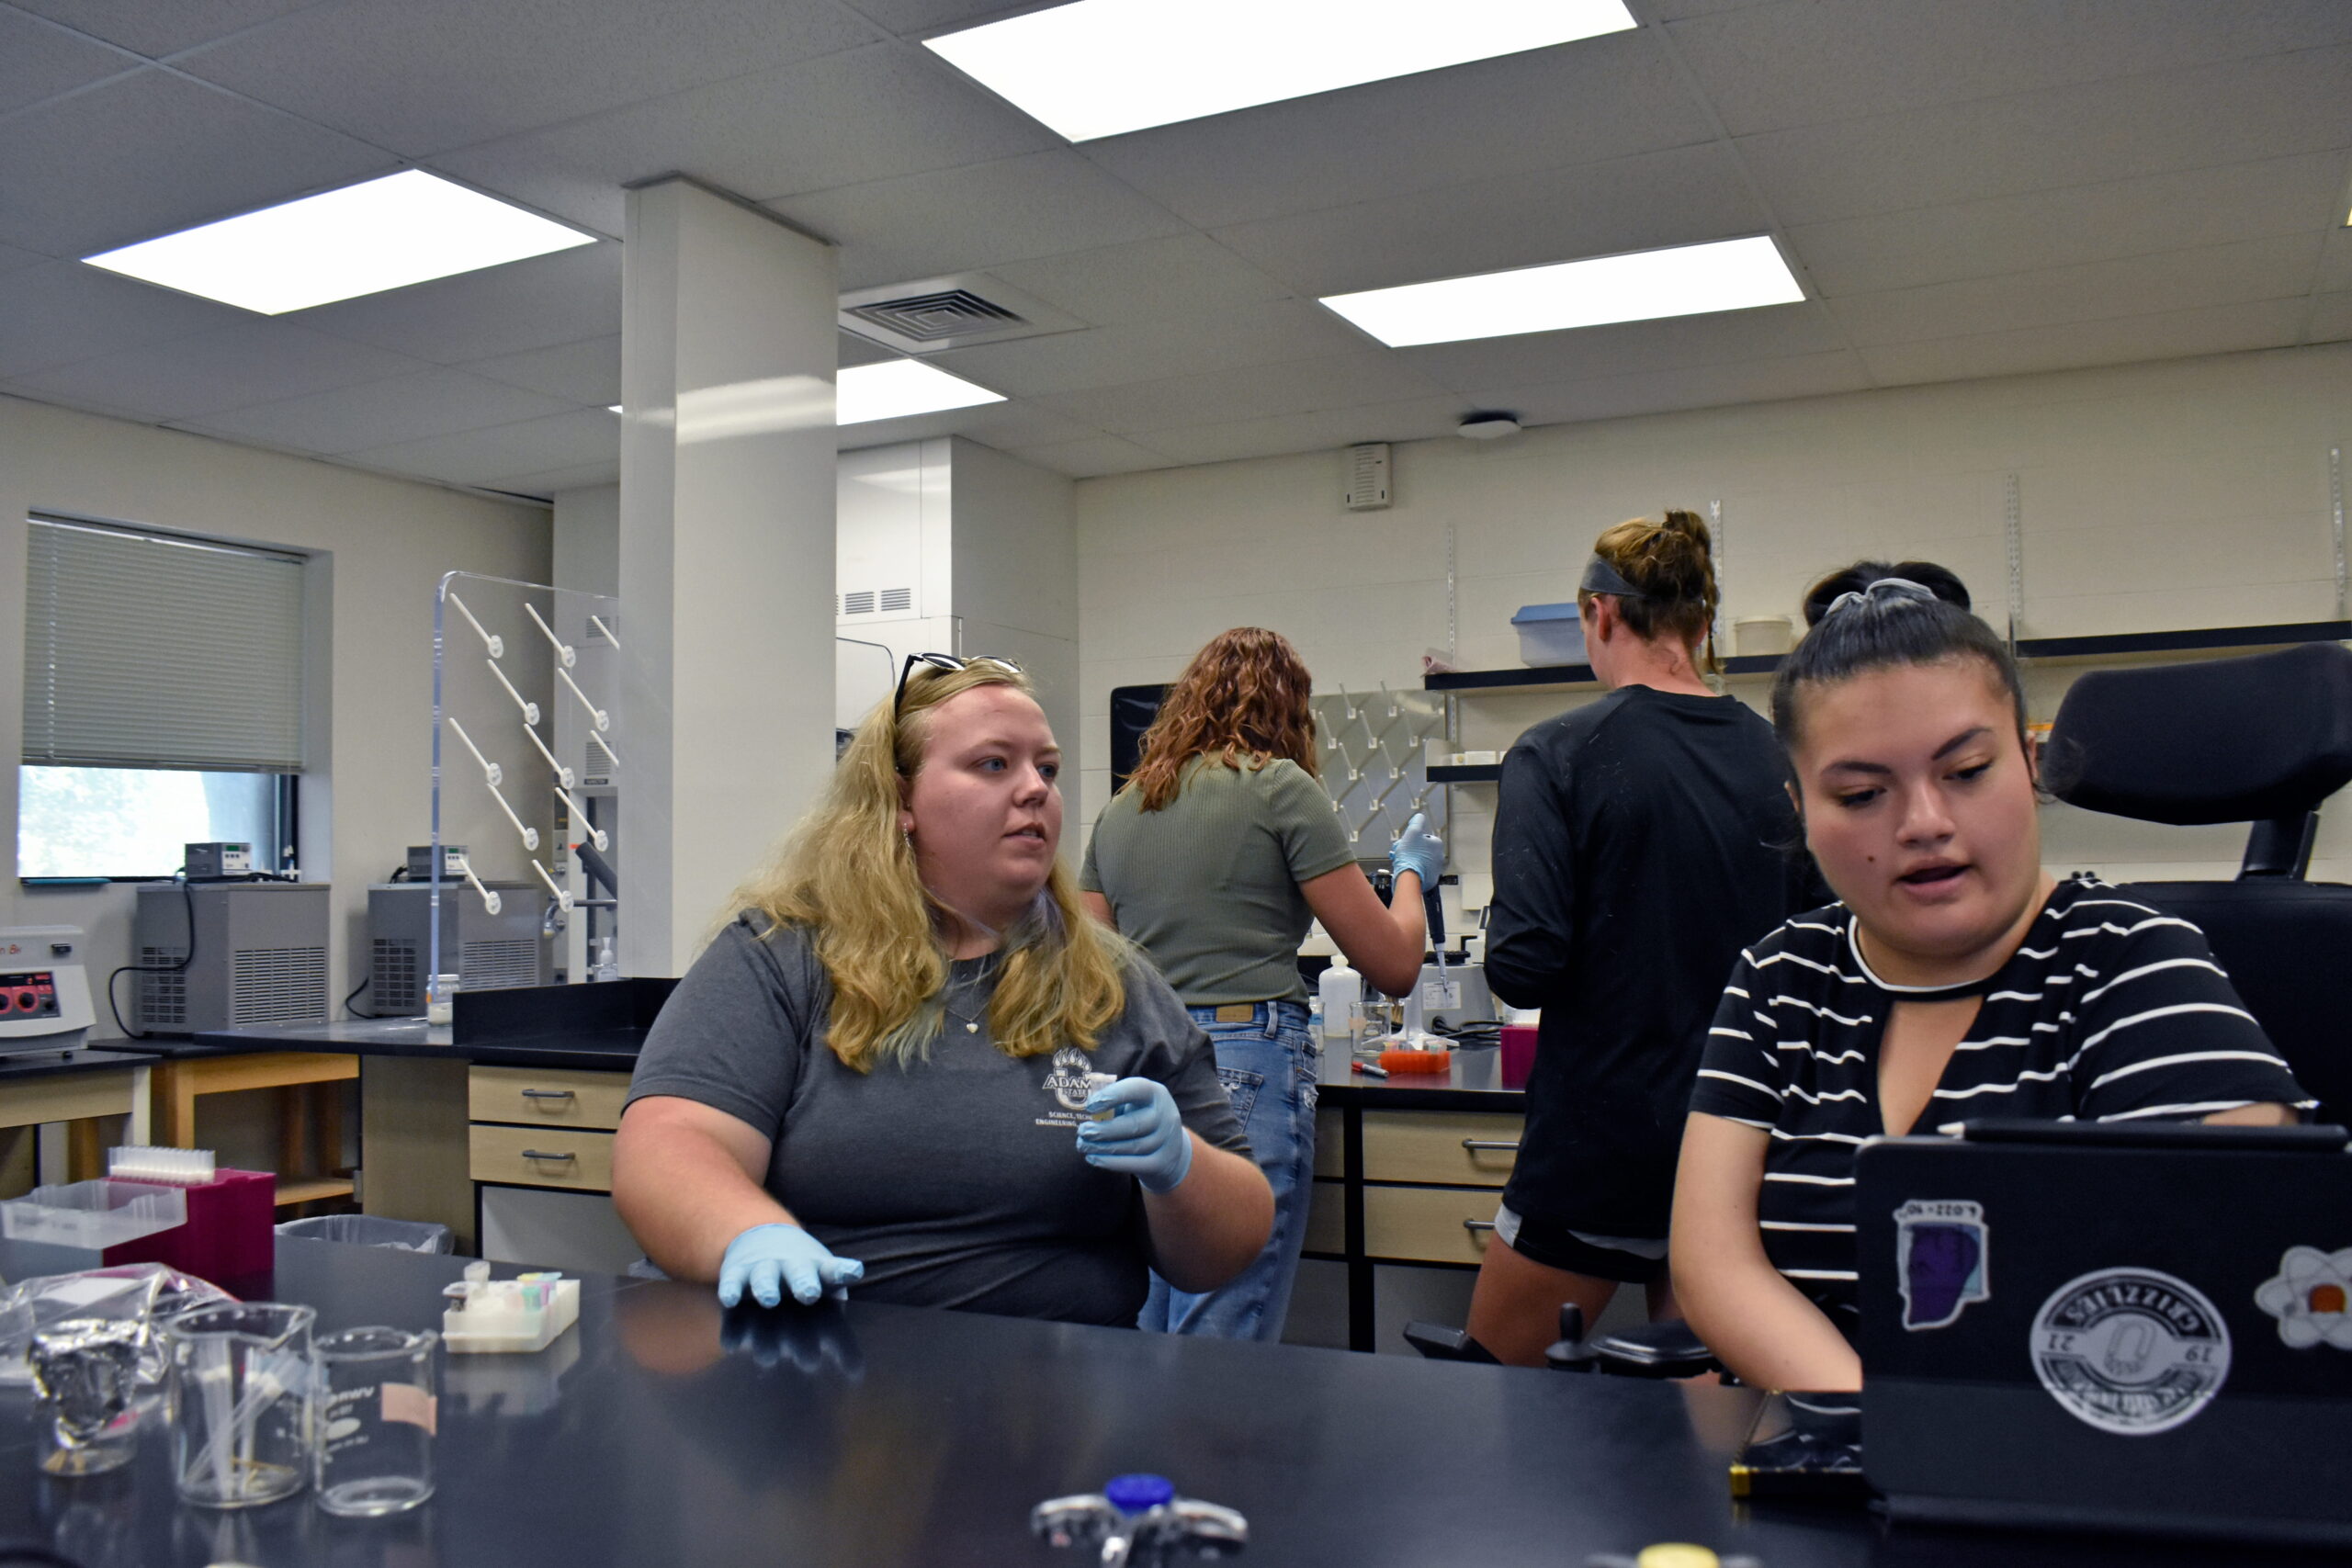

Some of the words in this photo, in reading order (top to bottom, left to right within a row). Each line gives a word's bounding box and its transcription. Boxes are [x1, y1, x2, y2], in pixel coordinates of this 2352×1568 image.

[1042, 1073, 1092, 1089] ADAM
[2066, 1285, 2201, 1332] GRIZZLIES
[2184, 1345, 2212, 1362] 19
